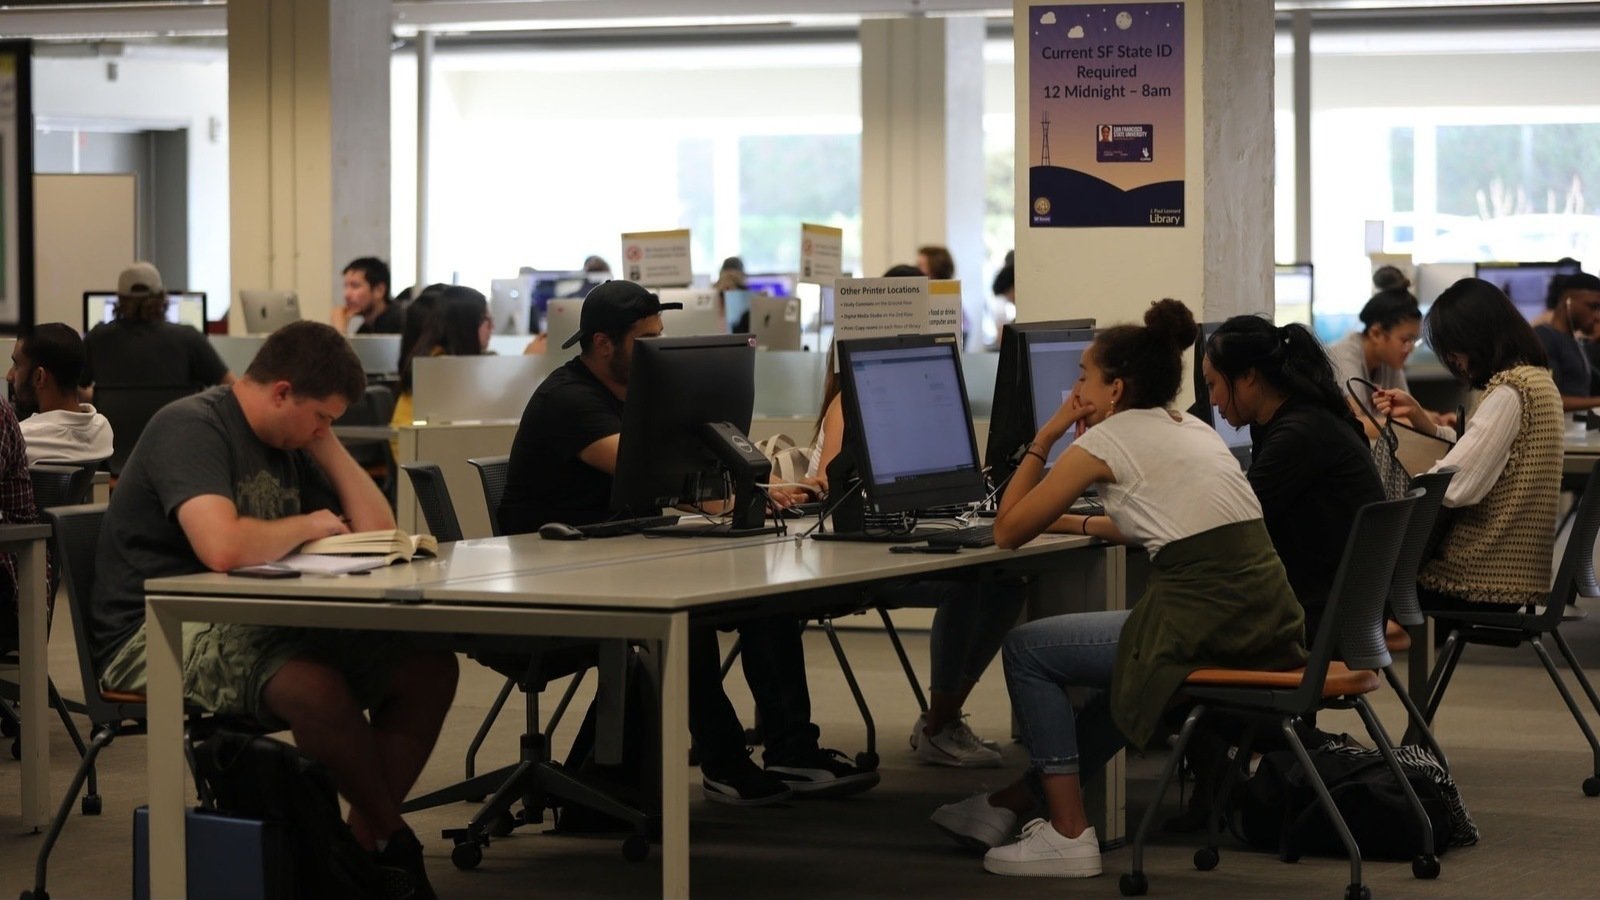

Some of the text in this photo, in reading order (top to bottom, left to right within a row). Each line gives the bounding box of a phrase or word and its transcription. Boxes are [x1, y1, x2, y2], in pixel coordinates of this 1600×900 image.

[1042, 44, 1172, 59] Current SF State ID
[1077, 65, 1137, 80] Required
[1044, 86, 1060, 98] 12
[1065, 85, 1125, 100] Midnight
[1142, 84, 1171, 97] 8am
[1150, 213, 1180, 224] Library
[862, 287, 886, 295] Printer
[888, 286, 920, 294] Locations
[931, 308, 939, 316] food
[945, 307, 957, 315] drinks
